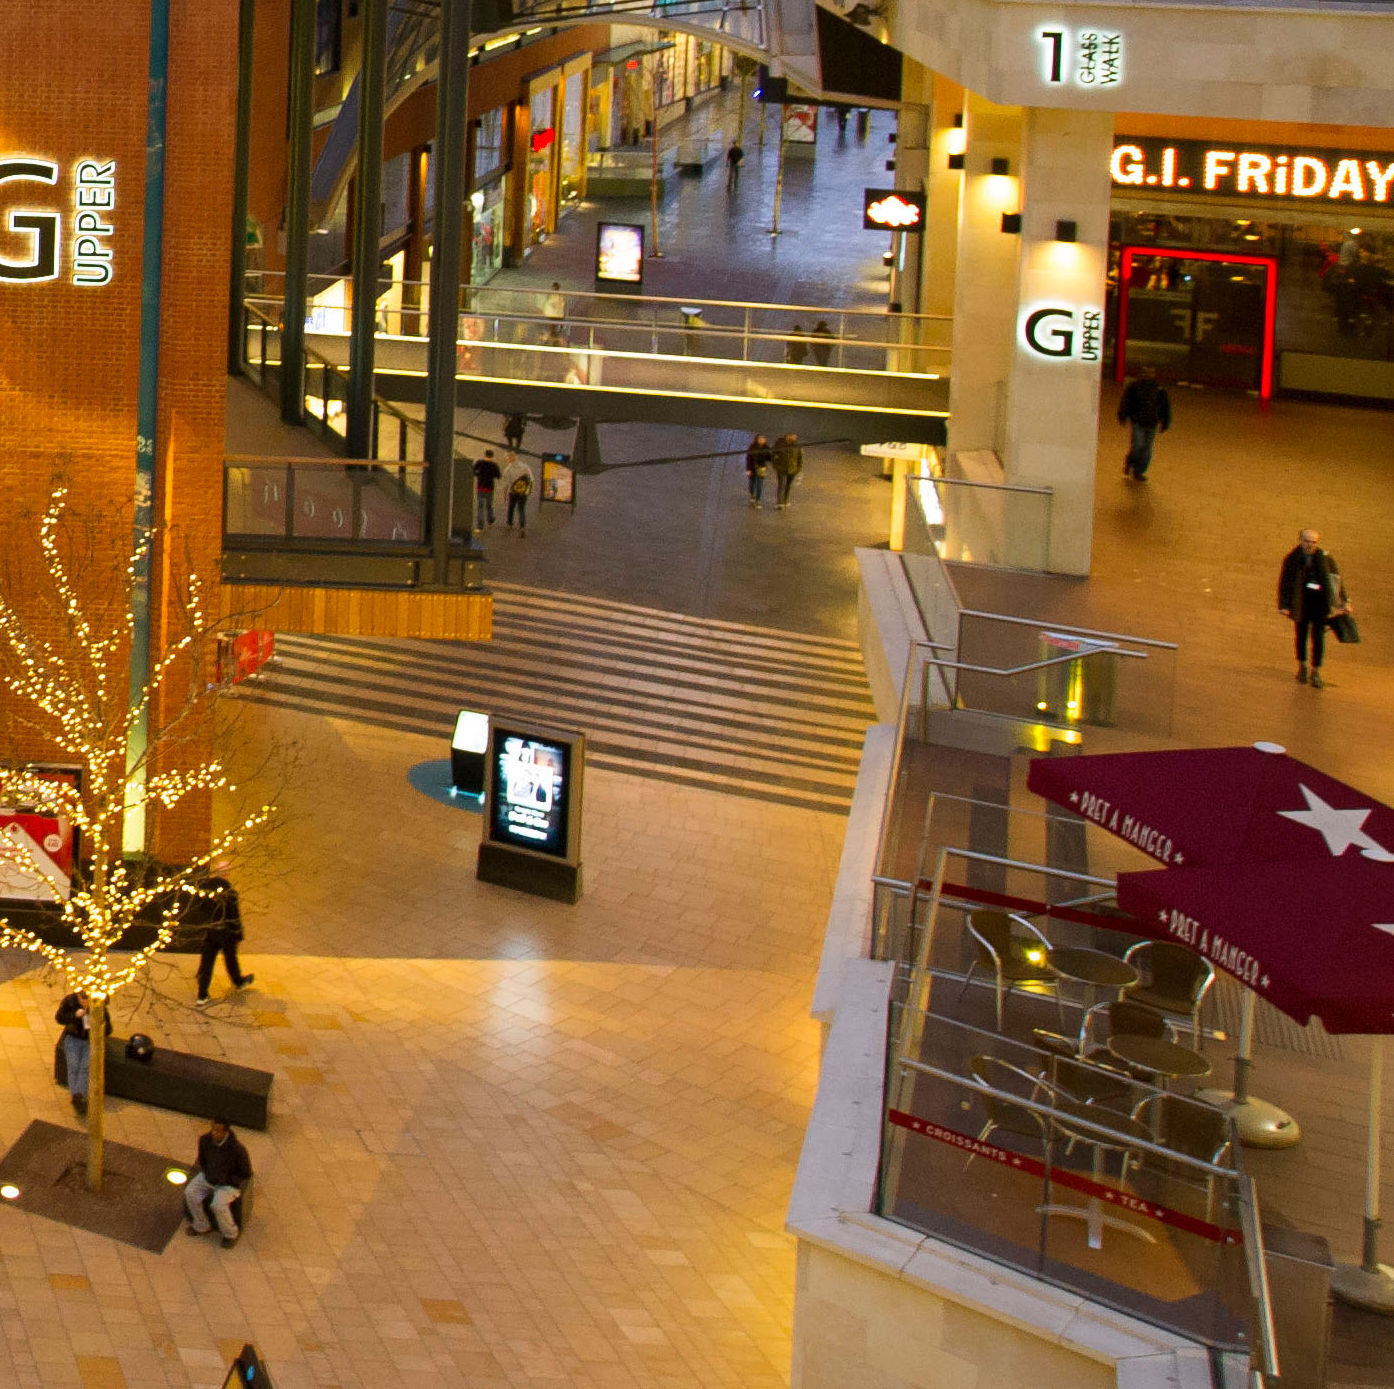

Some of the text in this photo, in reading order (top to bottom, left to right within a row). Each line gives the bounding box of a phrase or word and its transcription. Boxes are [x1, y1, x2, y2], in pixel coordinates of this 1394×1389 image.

[1042, 32, 1062, 82] 1
[1080, 33, 1098, 84] GLASS
[1100, 34, 1121, 84] WALK
[72, 159, 116, 286] UPPER
[1025, 308, 1074, 357] G
[1081, 311, 1101, 361] UPPER
[1080, 791, 1173, 862] PRET A MANGER
[1170, 909, 1260, 986] PRET A MANGER
[925, 1124, 1009, 1161] CROISSANTS
[1122, 1195, 1150, 1213] TEA
